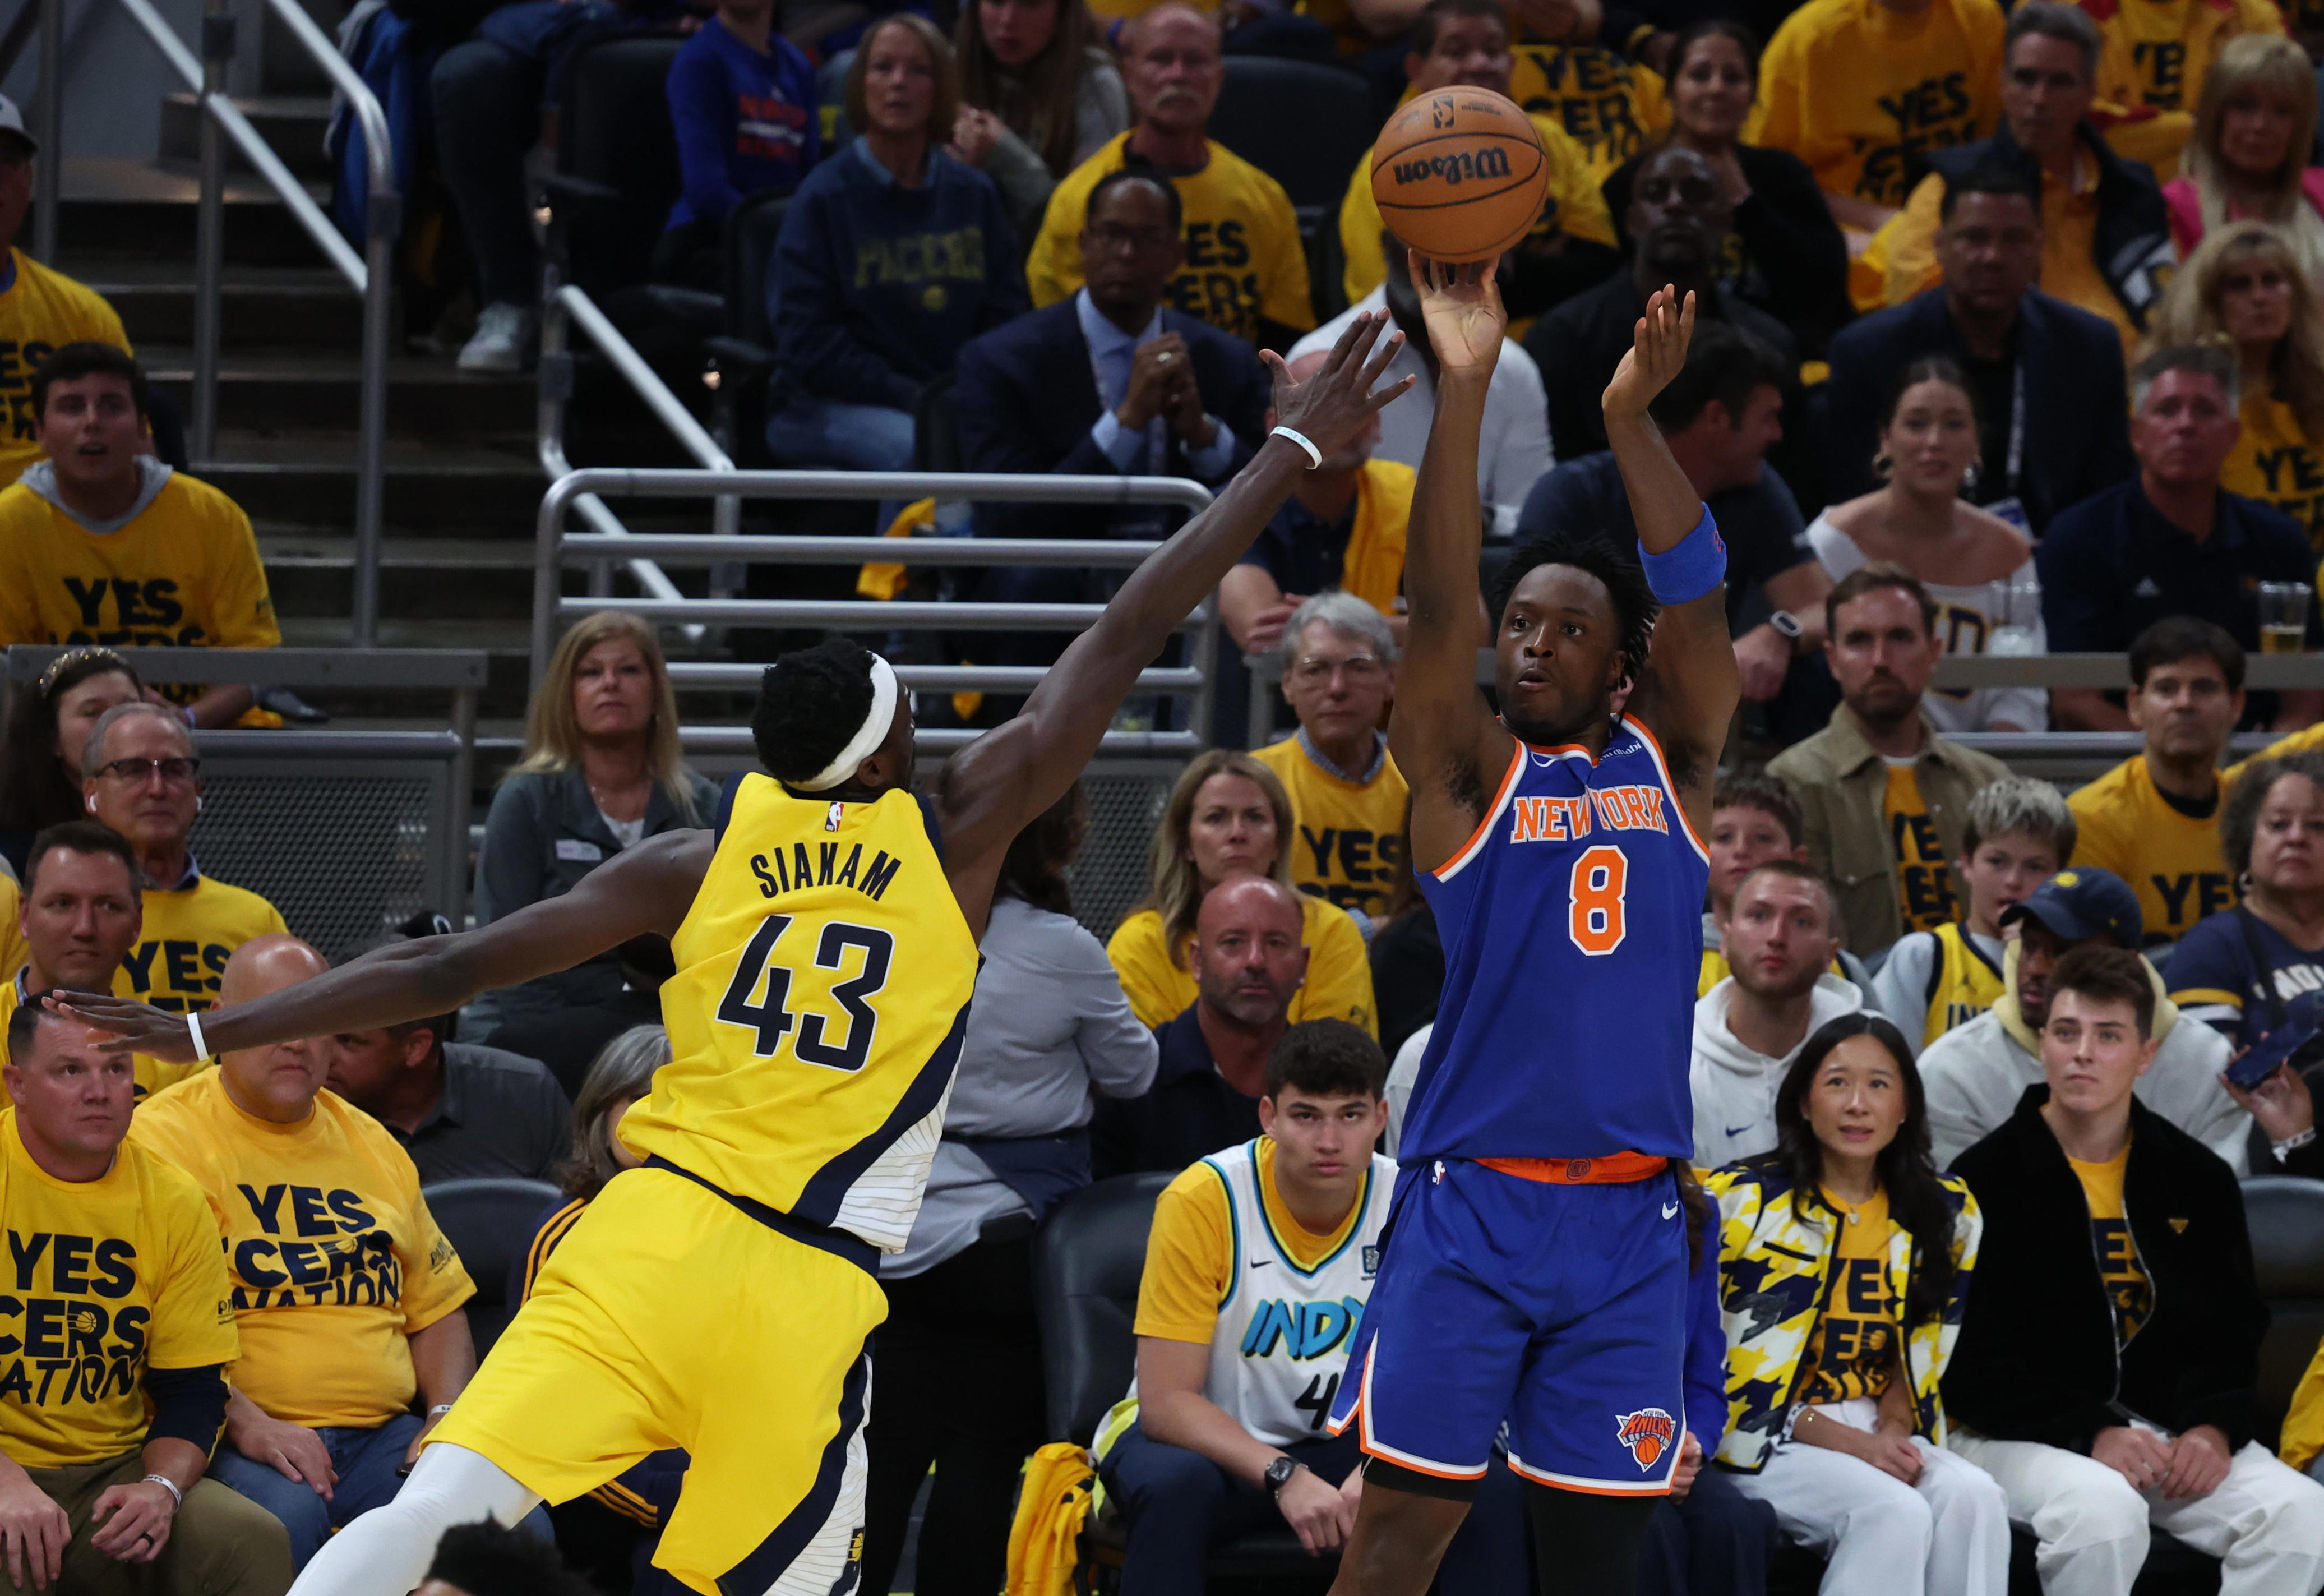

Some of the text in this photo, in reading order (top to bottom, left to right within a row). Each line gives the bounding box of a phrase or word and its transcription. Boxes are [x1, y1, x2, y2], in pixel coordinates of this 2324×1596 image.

[1878, 72, 1969, 130] YES
[1393, 146, 1512, 186] Wilson
[1186, 220, 1249, 267] ES
[63, 578, 183, 626] YES
[1510, 785, 1669, 844] NEW YORK
[750, 842, 901, 902] SIAKAM
[1301, 826, 1401, 883] YES
[1569, 845, 1629, 956] 8
[122, 939, 231, 993] YES
[715, 914, 895, 1073] 43
[237, 1183, 377, 1237] YES
[7, 1228, 137, 1299] YES
[0, 1356, 144, 1407] ATION
[1620, 1413, 1672, 1441] KNICKS
